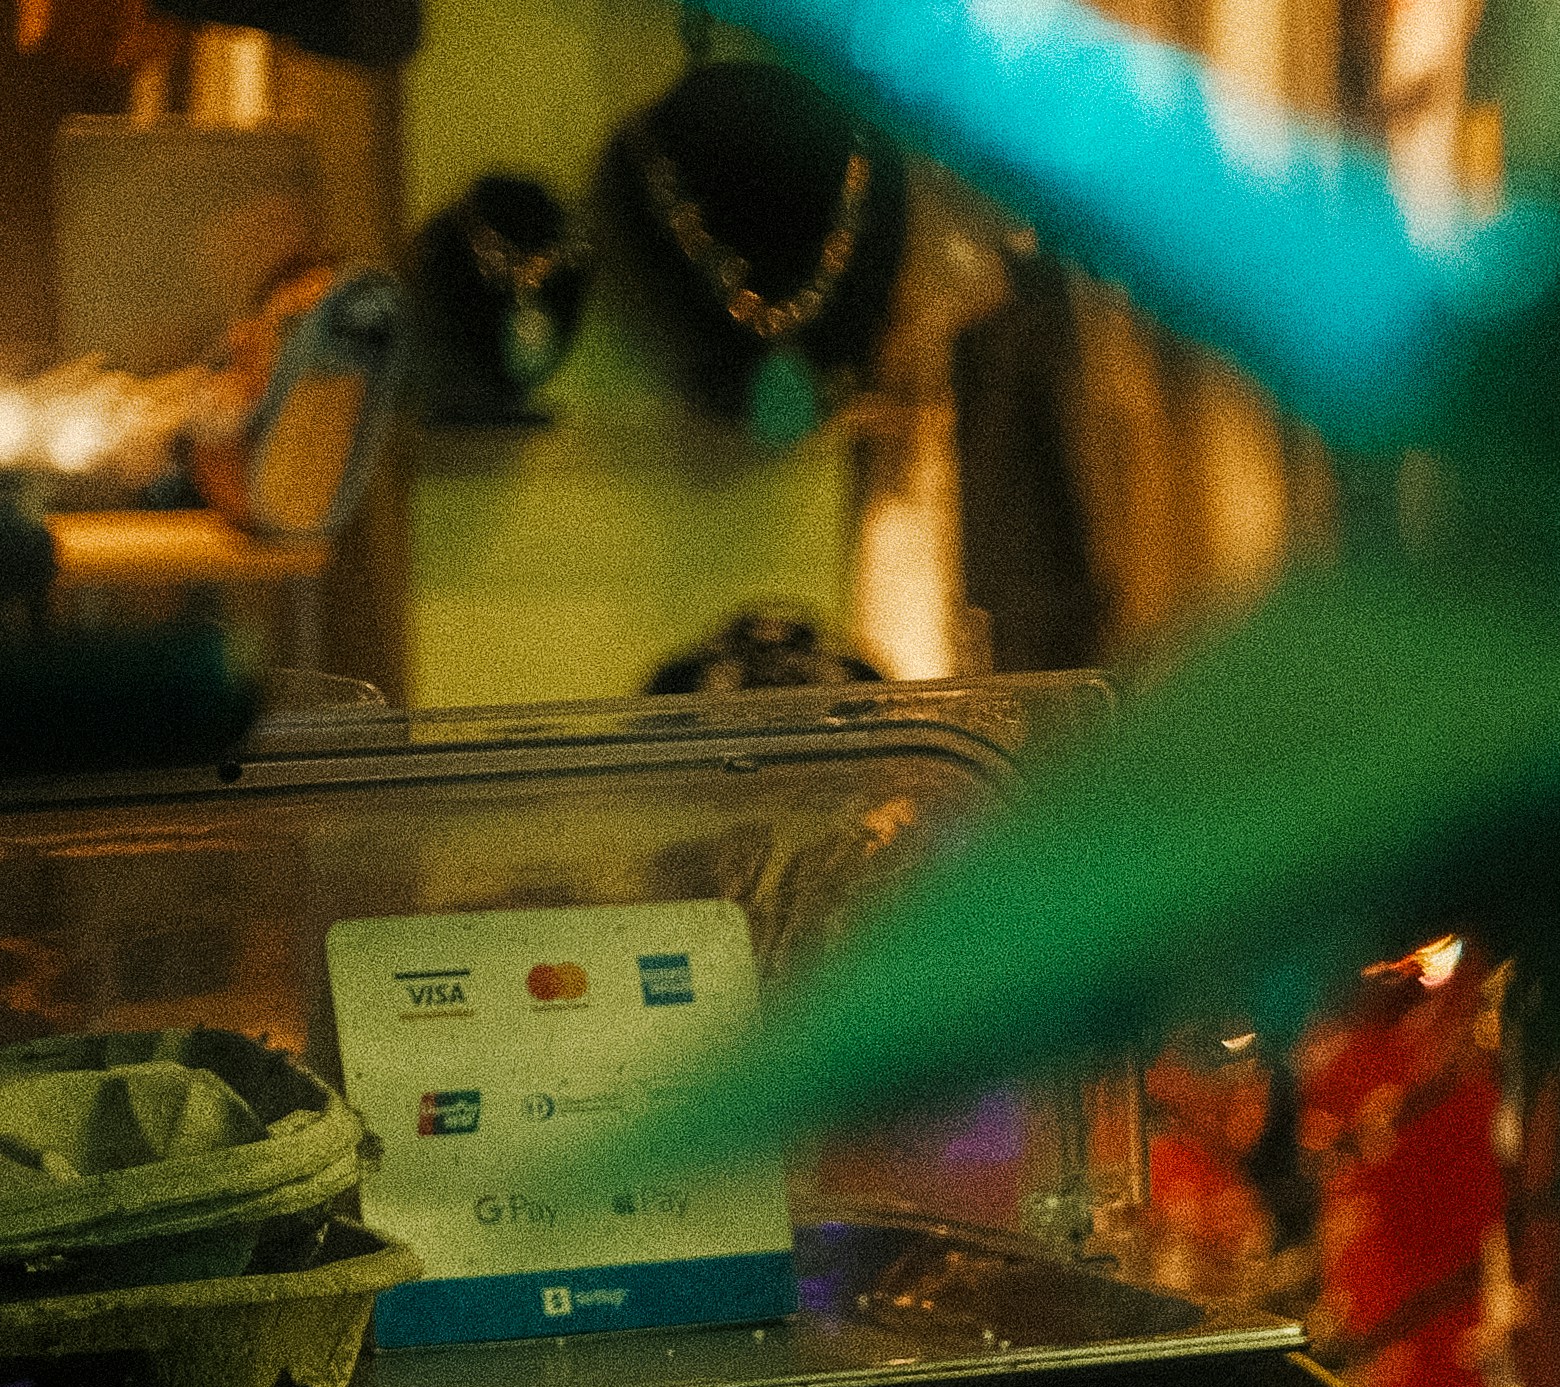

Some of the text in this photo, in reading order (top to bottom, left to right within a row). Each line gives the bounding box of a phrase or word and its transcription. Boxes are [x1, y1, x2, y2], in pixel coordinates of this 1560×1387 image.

[408, 983, 467, 1005] VISA
[509, 1193, 556, 1227] Pay
[643, 1186, 688, 1217] Pay
